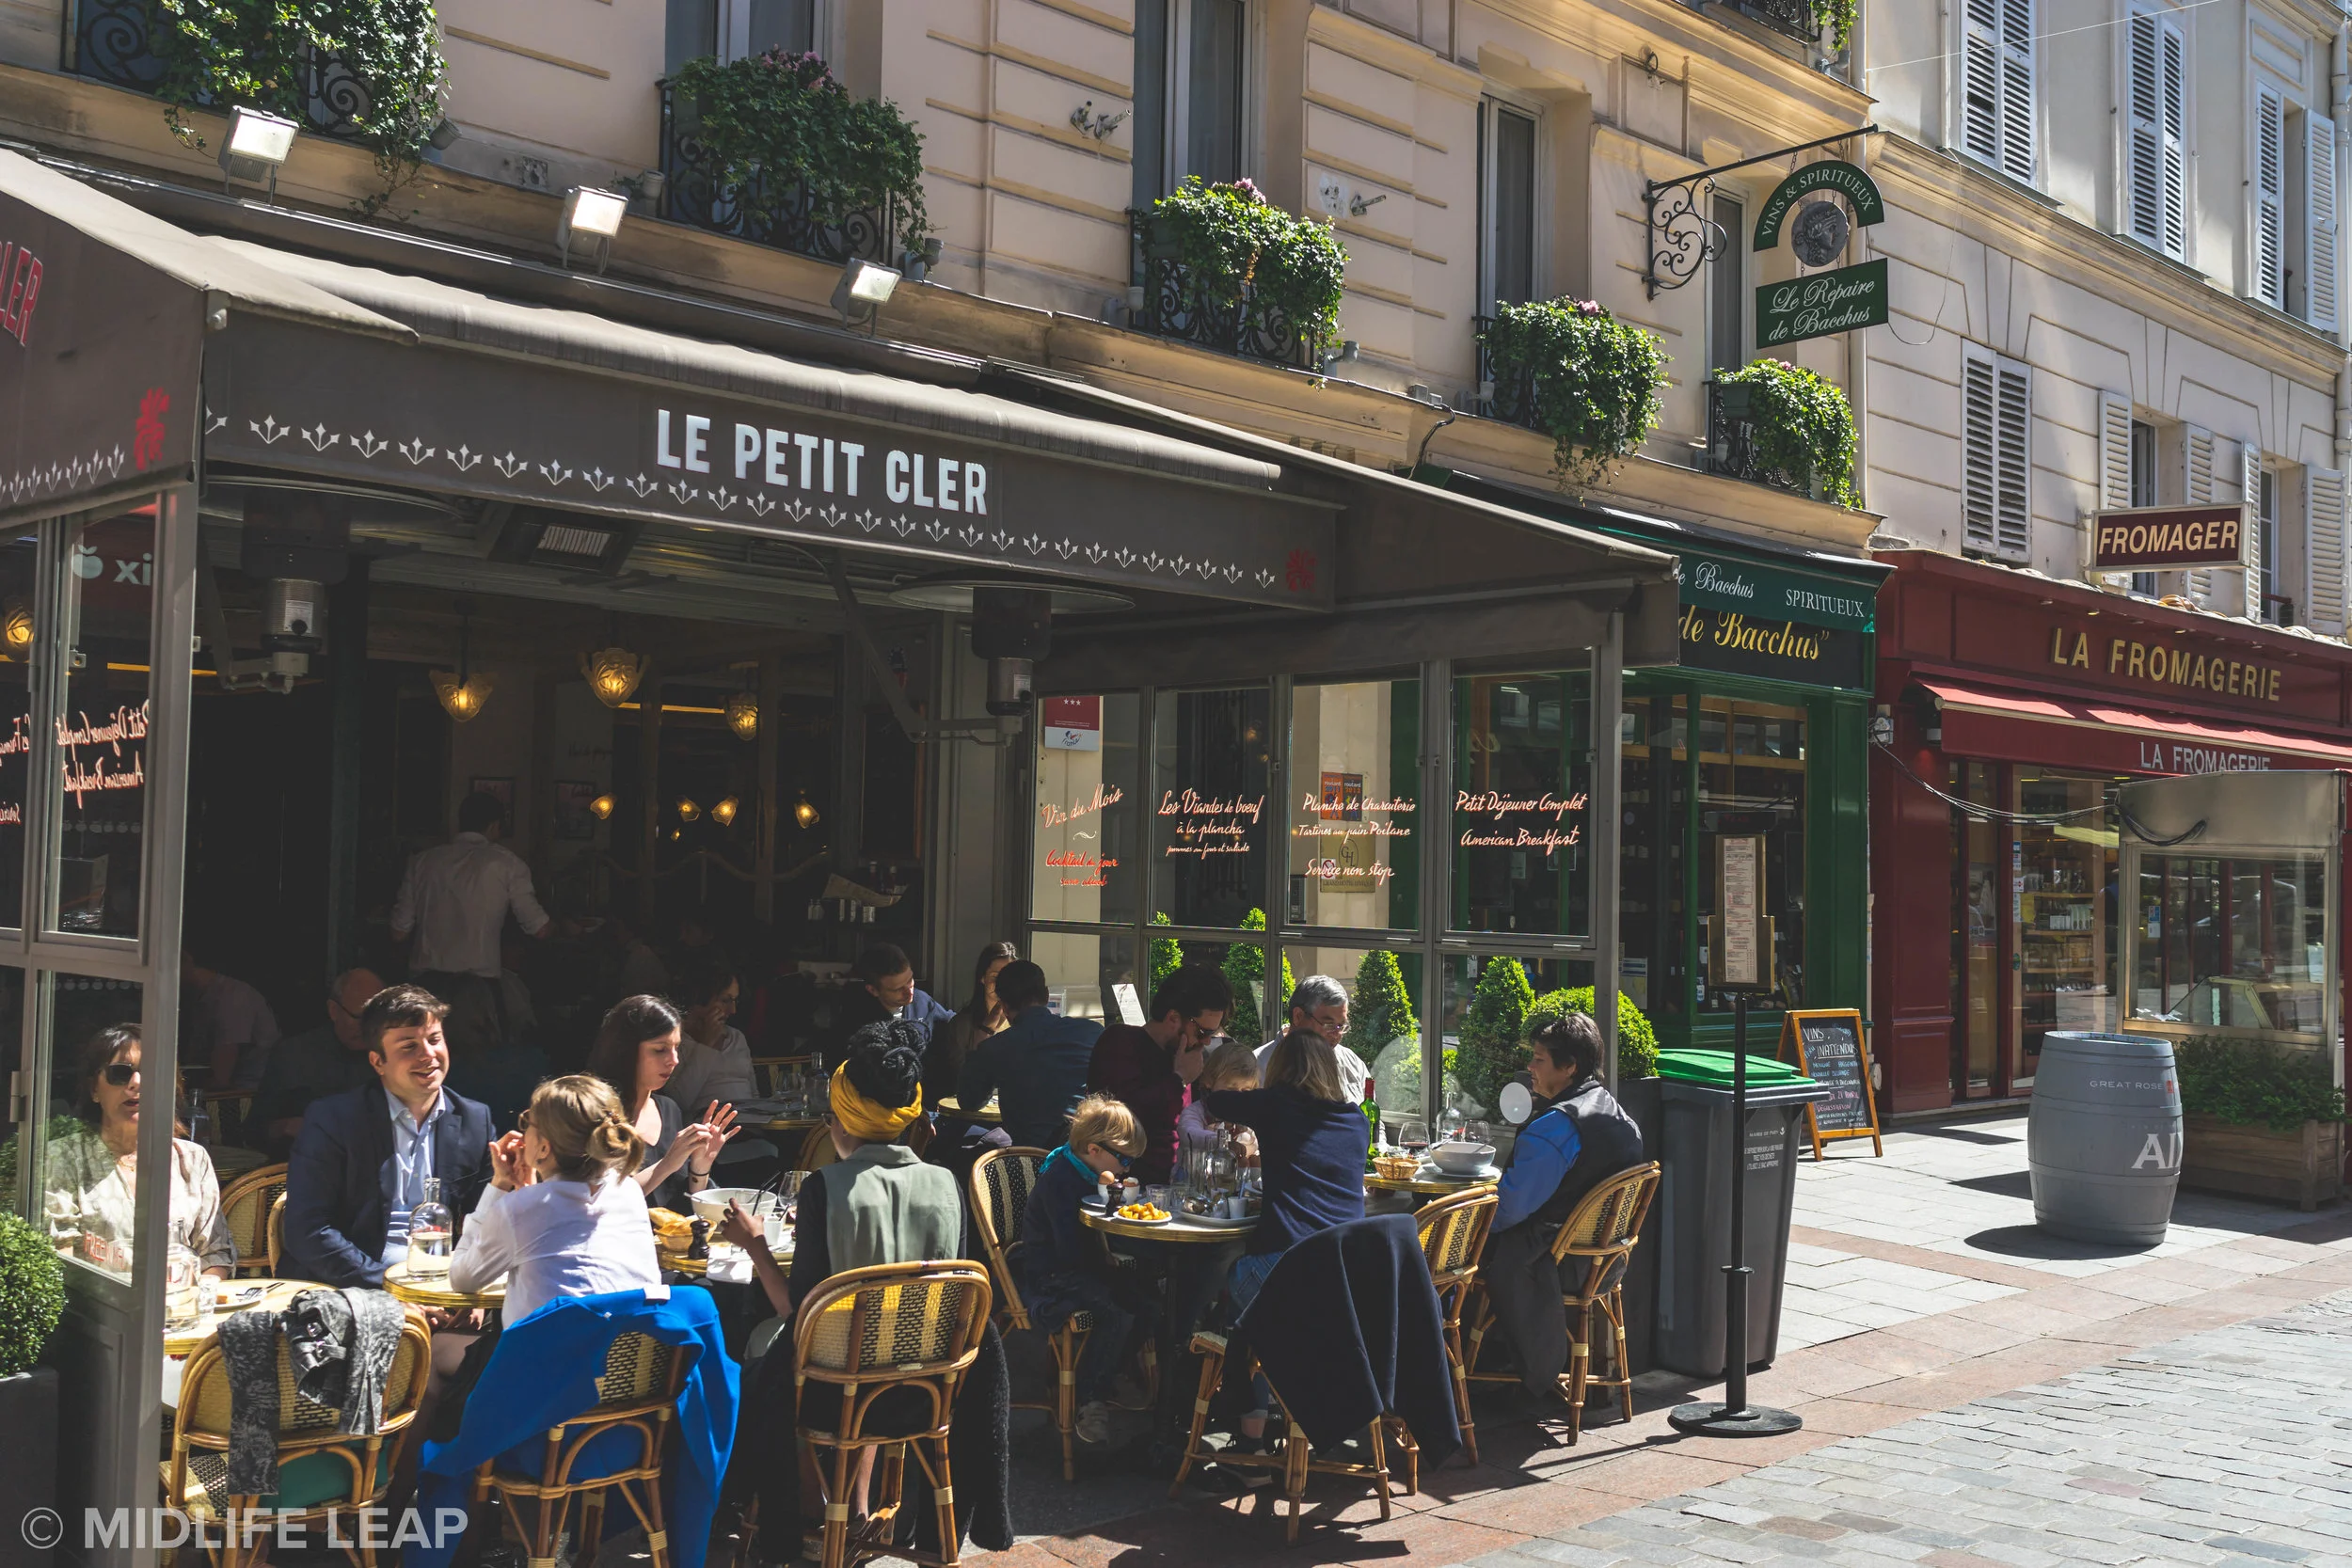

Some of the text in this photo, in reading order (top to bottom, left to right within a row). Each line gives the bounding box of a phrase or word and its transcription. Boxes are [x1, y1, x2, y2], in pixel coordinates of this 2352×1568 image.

[1762, 168, 1875, 236] VINS & SPIRITUEUX
[0, 240, 43, 347] LER
[1770, 277, 1876, 314] Le Repaire
[1769, 305, 1871, 342] de Bacchus
[657, 408, 987, 515] LE PETIT CLER
[2097, 519, 2239, 555] FROMAGER
[1694, 562, 1755, 599] Bacchus
[1786, 588, 1866, 619] SPIRITUEUX
[2051, 627, 2282, 702] LA FROMAGERIE
[2139, 741, 2164, 770] LA
[1041, 784, 1124, 829] Vin du Mois
[1157, 789, 1182, 816] Les
[1182, 787, 1223, 816] Viandes
[1224, 800, 1234, 815] de
[1302, 792, 1417, 813] Planche de Charcuterie
[1454, 790, 1487, 813] Petit
[1538, 792, 1589, 822] Complet
[1186, 818, 1199, 834] la
[1198, 817, 1247, 843] plancha
[1298, 823, 1332, 838] Tartines
[1343, 823, 1369, 845] pain
[1460, 825, 1581, 857] American Breakfast
[1304, 858, 1397, 887] Service non stop
[1803, 1025, 1824, 1041] VINS
[2090, 1080, 2132, 1089] GREAT
